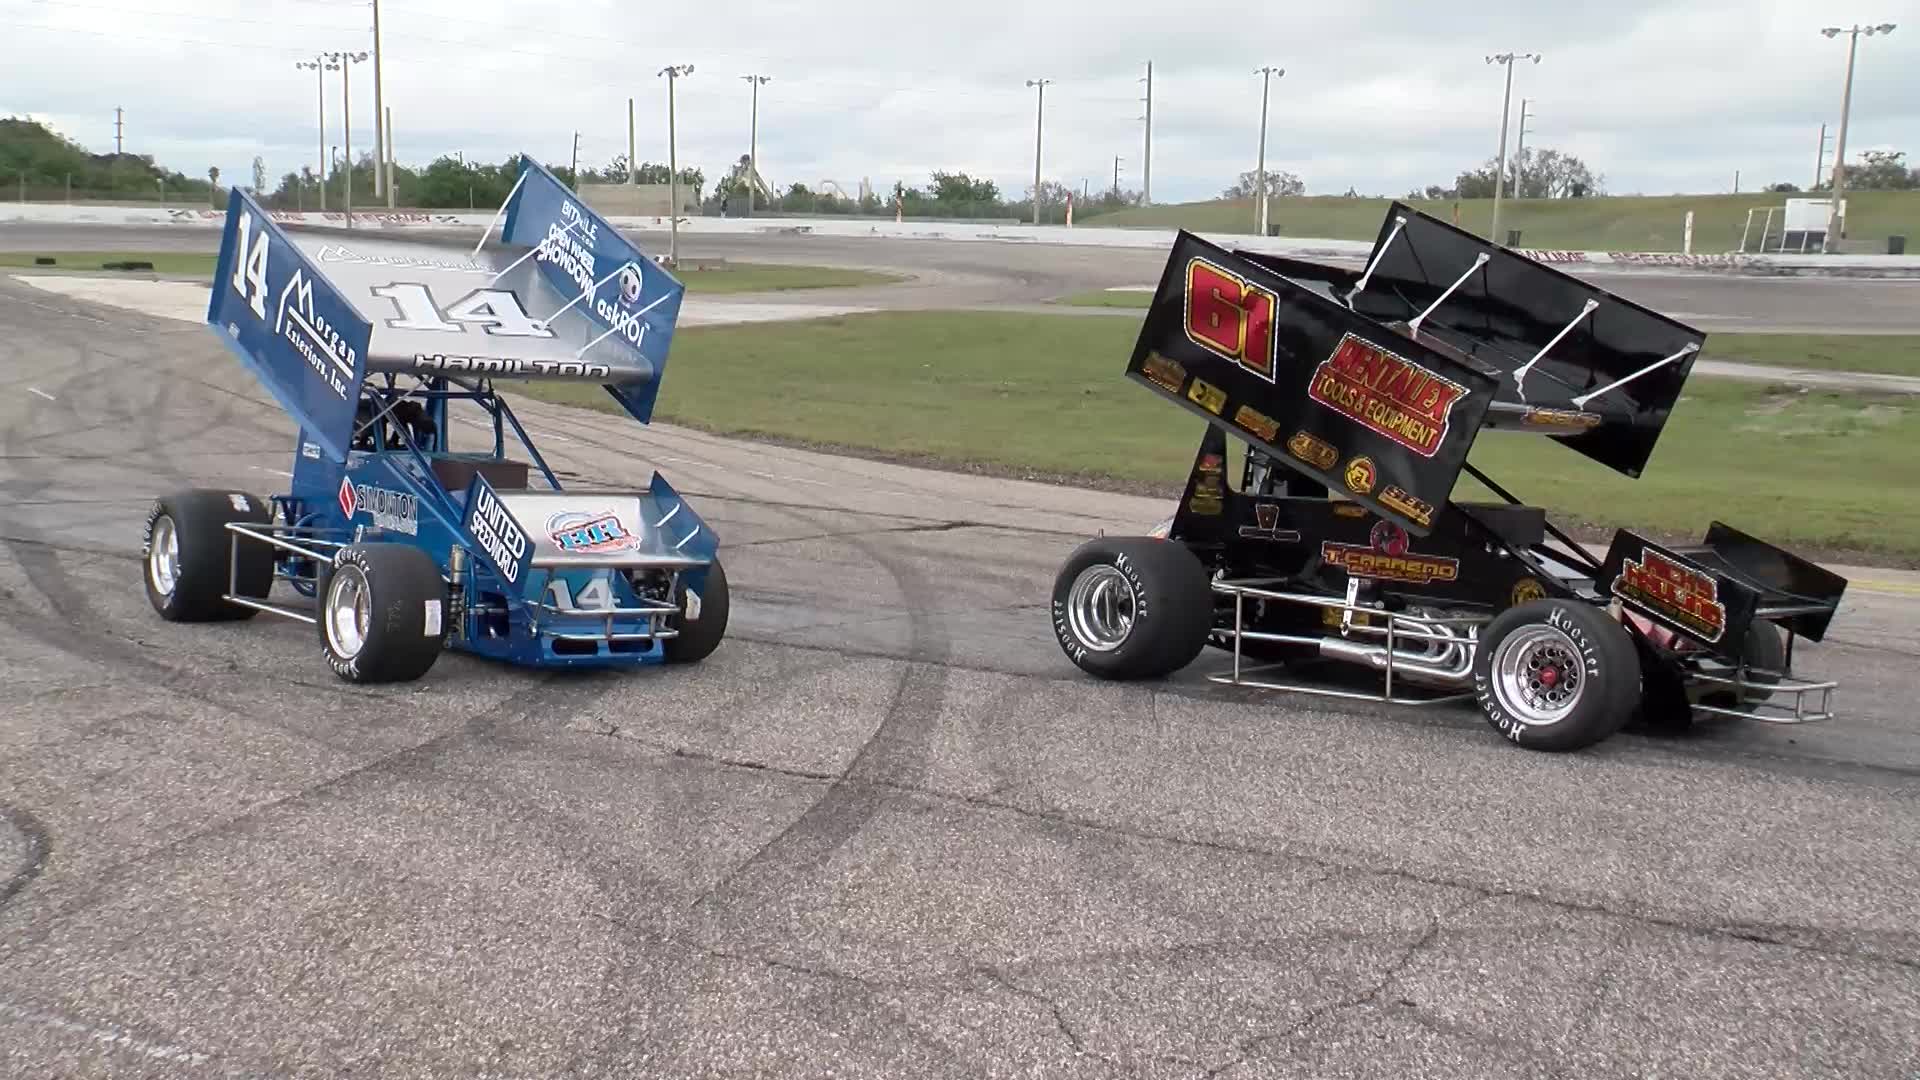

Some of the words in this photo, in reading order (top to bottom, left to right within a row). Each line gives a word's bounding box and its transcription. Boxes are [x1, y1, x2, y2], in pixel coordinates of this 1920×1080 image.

[233, 211, 270, 321] 14
[537, 238, 597, 308] SHOWDOWN
[276, 268, 356, 367] Morgan
[369, 281, 559, 339] 14
[1187, 259, 1276, 376] 61
[285, 320, 329, 382] Exteriors,
[331, 368, 348, 401] Inc.
[413, 354, 610, 377] HAMILTON
[1316, 374, 1358, 408] TOOLS
[1354, 393, 1364, 413] &
[1365, 400, 1438, 447] EQUIPMENT
[357, 484, 418, 520] SIMONTON
[477, 485, 525, 559] UNITED
[470, 510, 519, 583] SPEEDWORLD
[548, 577, 621, 610] 14
